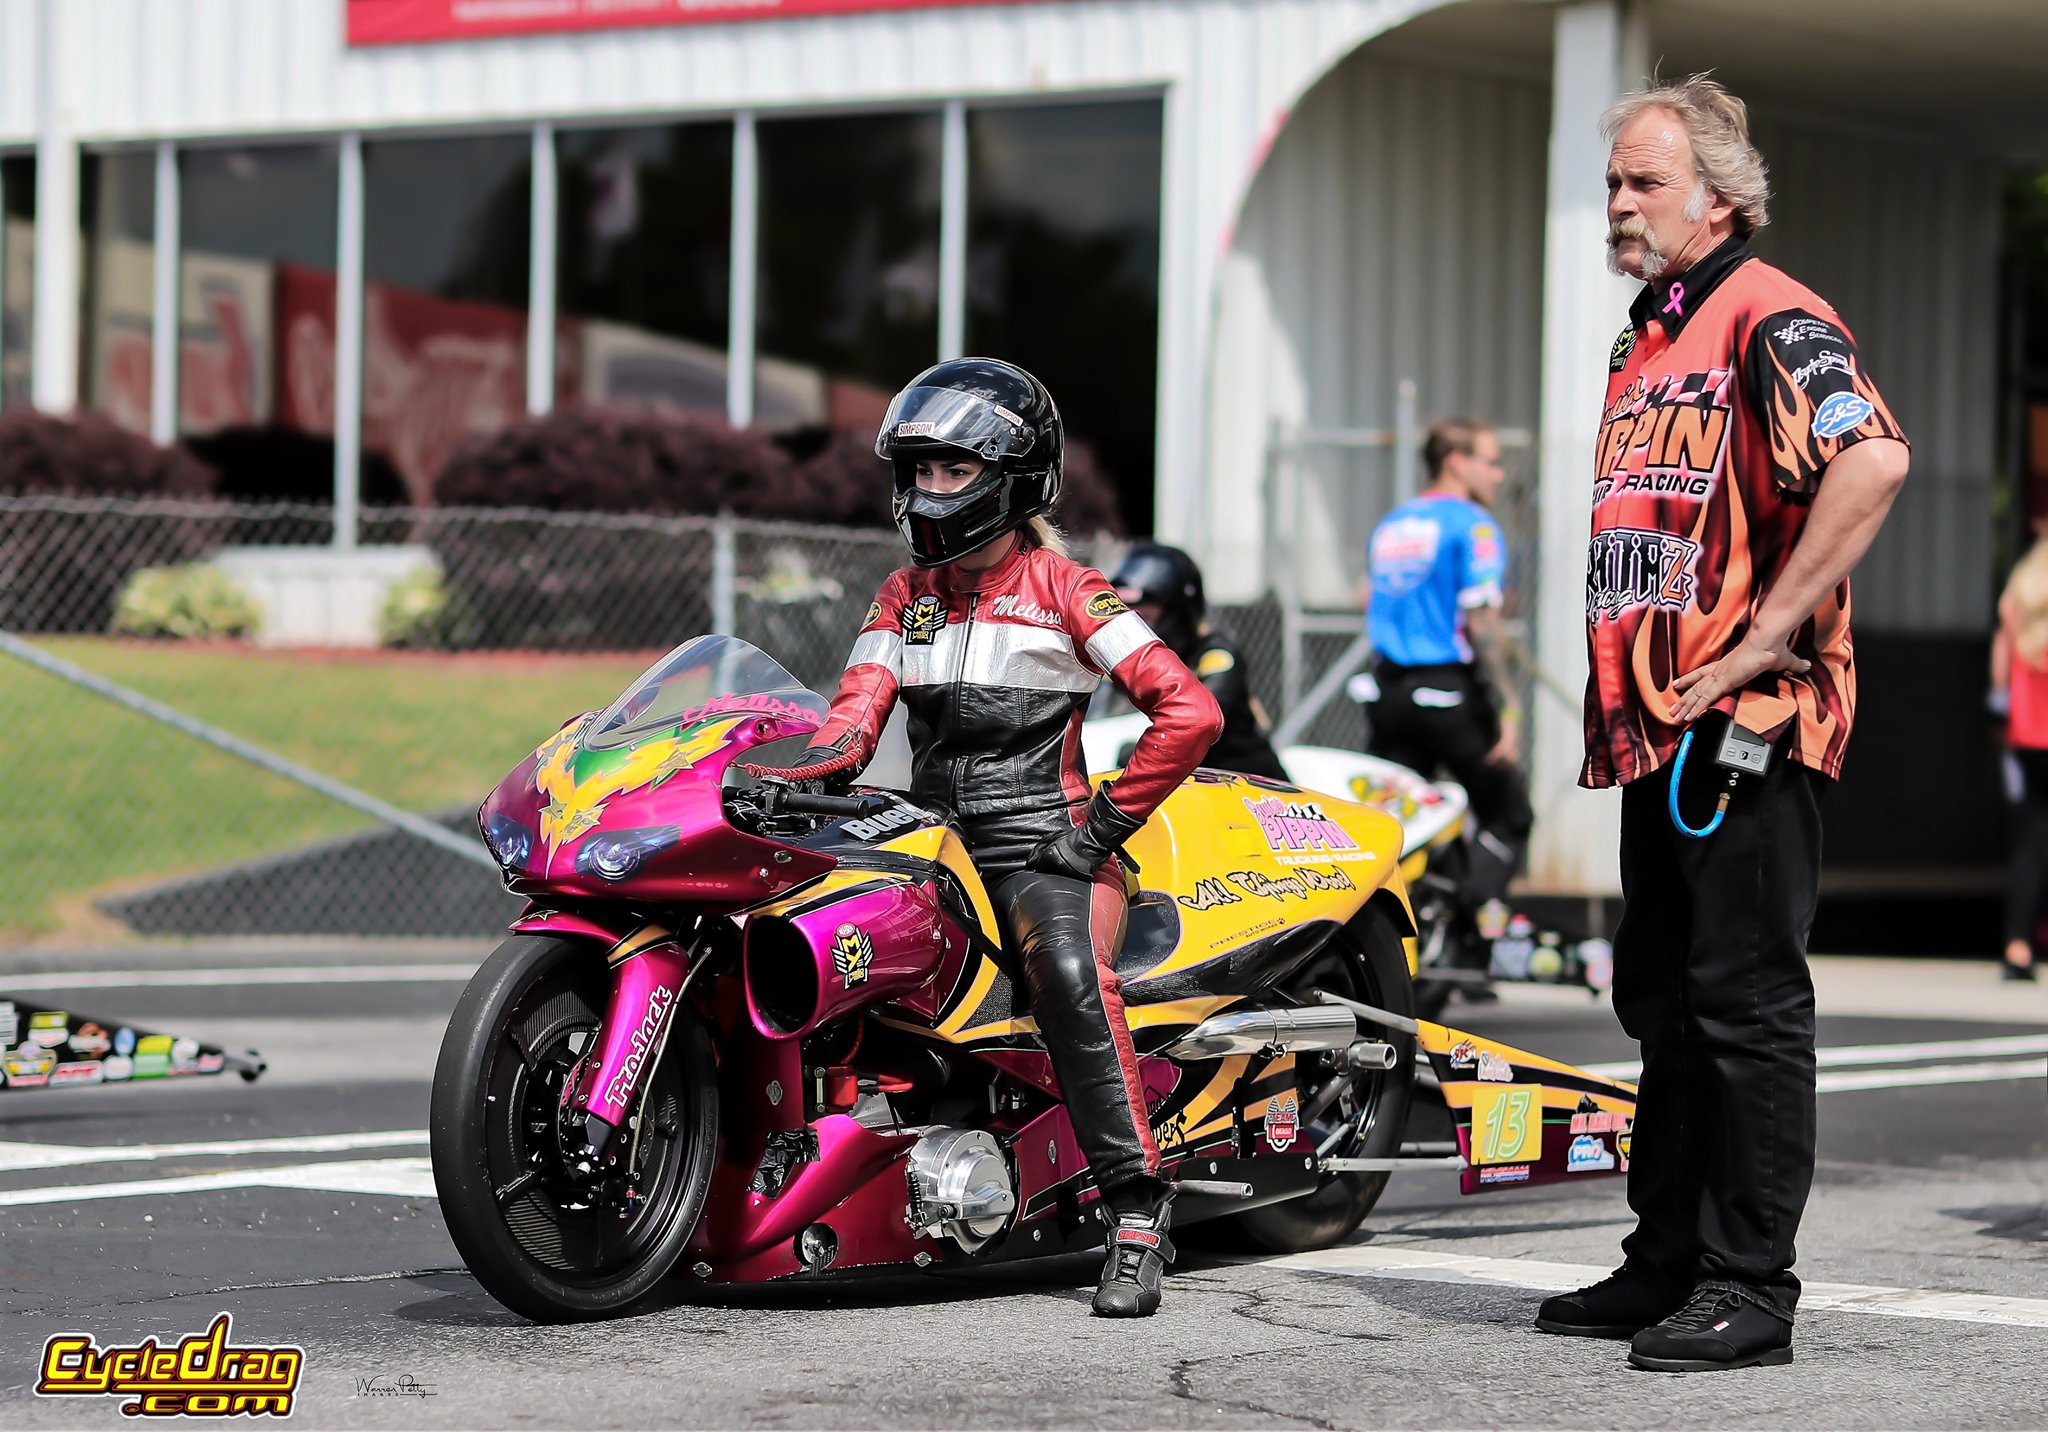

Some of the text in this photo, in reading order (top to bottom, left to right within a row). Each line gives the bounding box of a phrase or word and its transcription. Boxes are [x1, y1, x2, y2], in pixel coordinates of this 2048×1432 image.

[899, 423, 933, 436] SIMPSON
[996, 406, 1021, 424] SIMPSON
[1821, 400, 1862, 431] S&S
[1596, 404, 1729, 481] IPPIN
[1623, 474, 1709, 495] RACING
[993, 594, 1062, 625] Melissa
[1262, 817, 1357, 850] PIPPIN
[1486, 1091, 1531, 1159] 13
